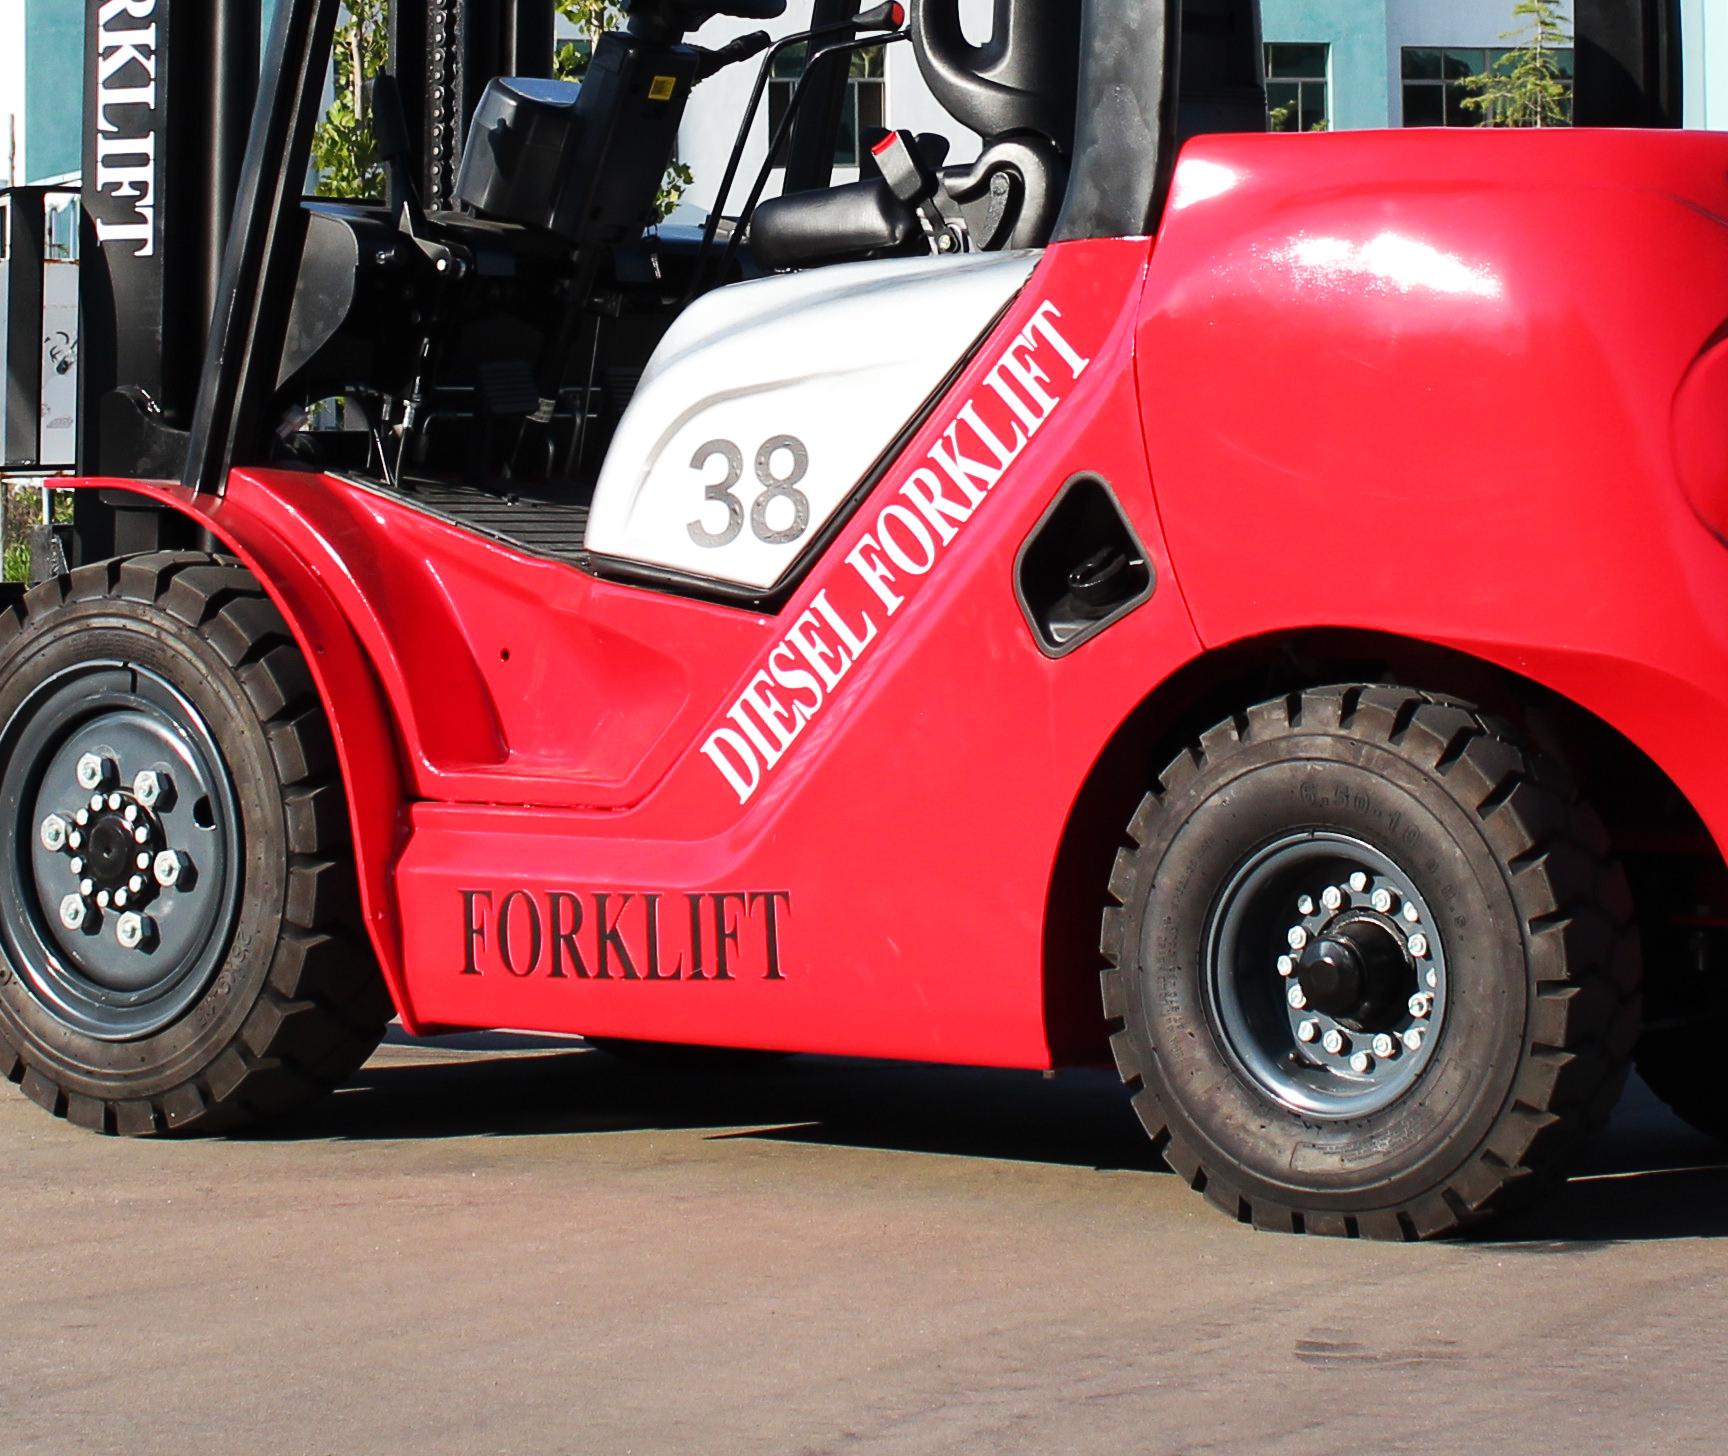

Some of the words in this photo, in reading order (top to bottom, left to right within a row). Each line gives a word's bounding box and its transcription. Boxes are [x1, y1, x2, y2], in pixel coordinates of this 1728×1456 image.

[686, 434, 810, 548] 38
[700, 589, 878, 805] DIESEL
[844, 299, 1090, 617] FORKLIFT
[457, 888, 791, 980] FORKLIFT
